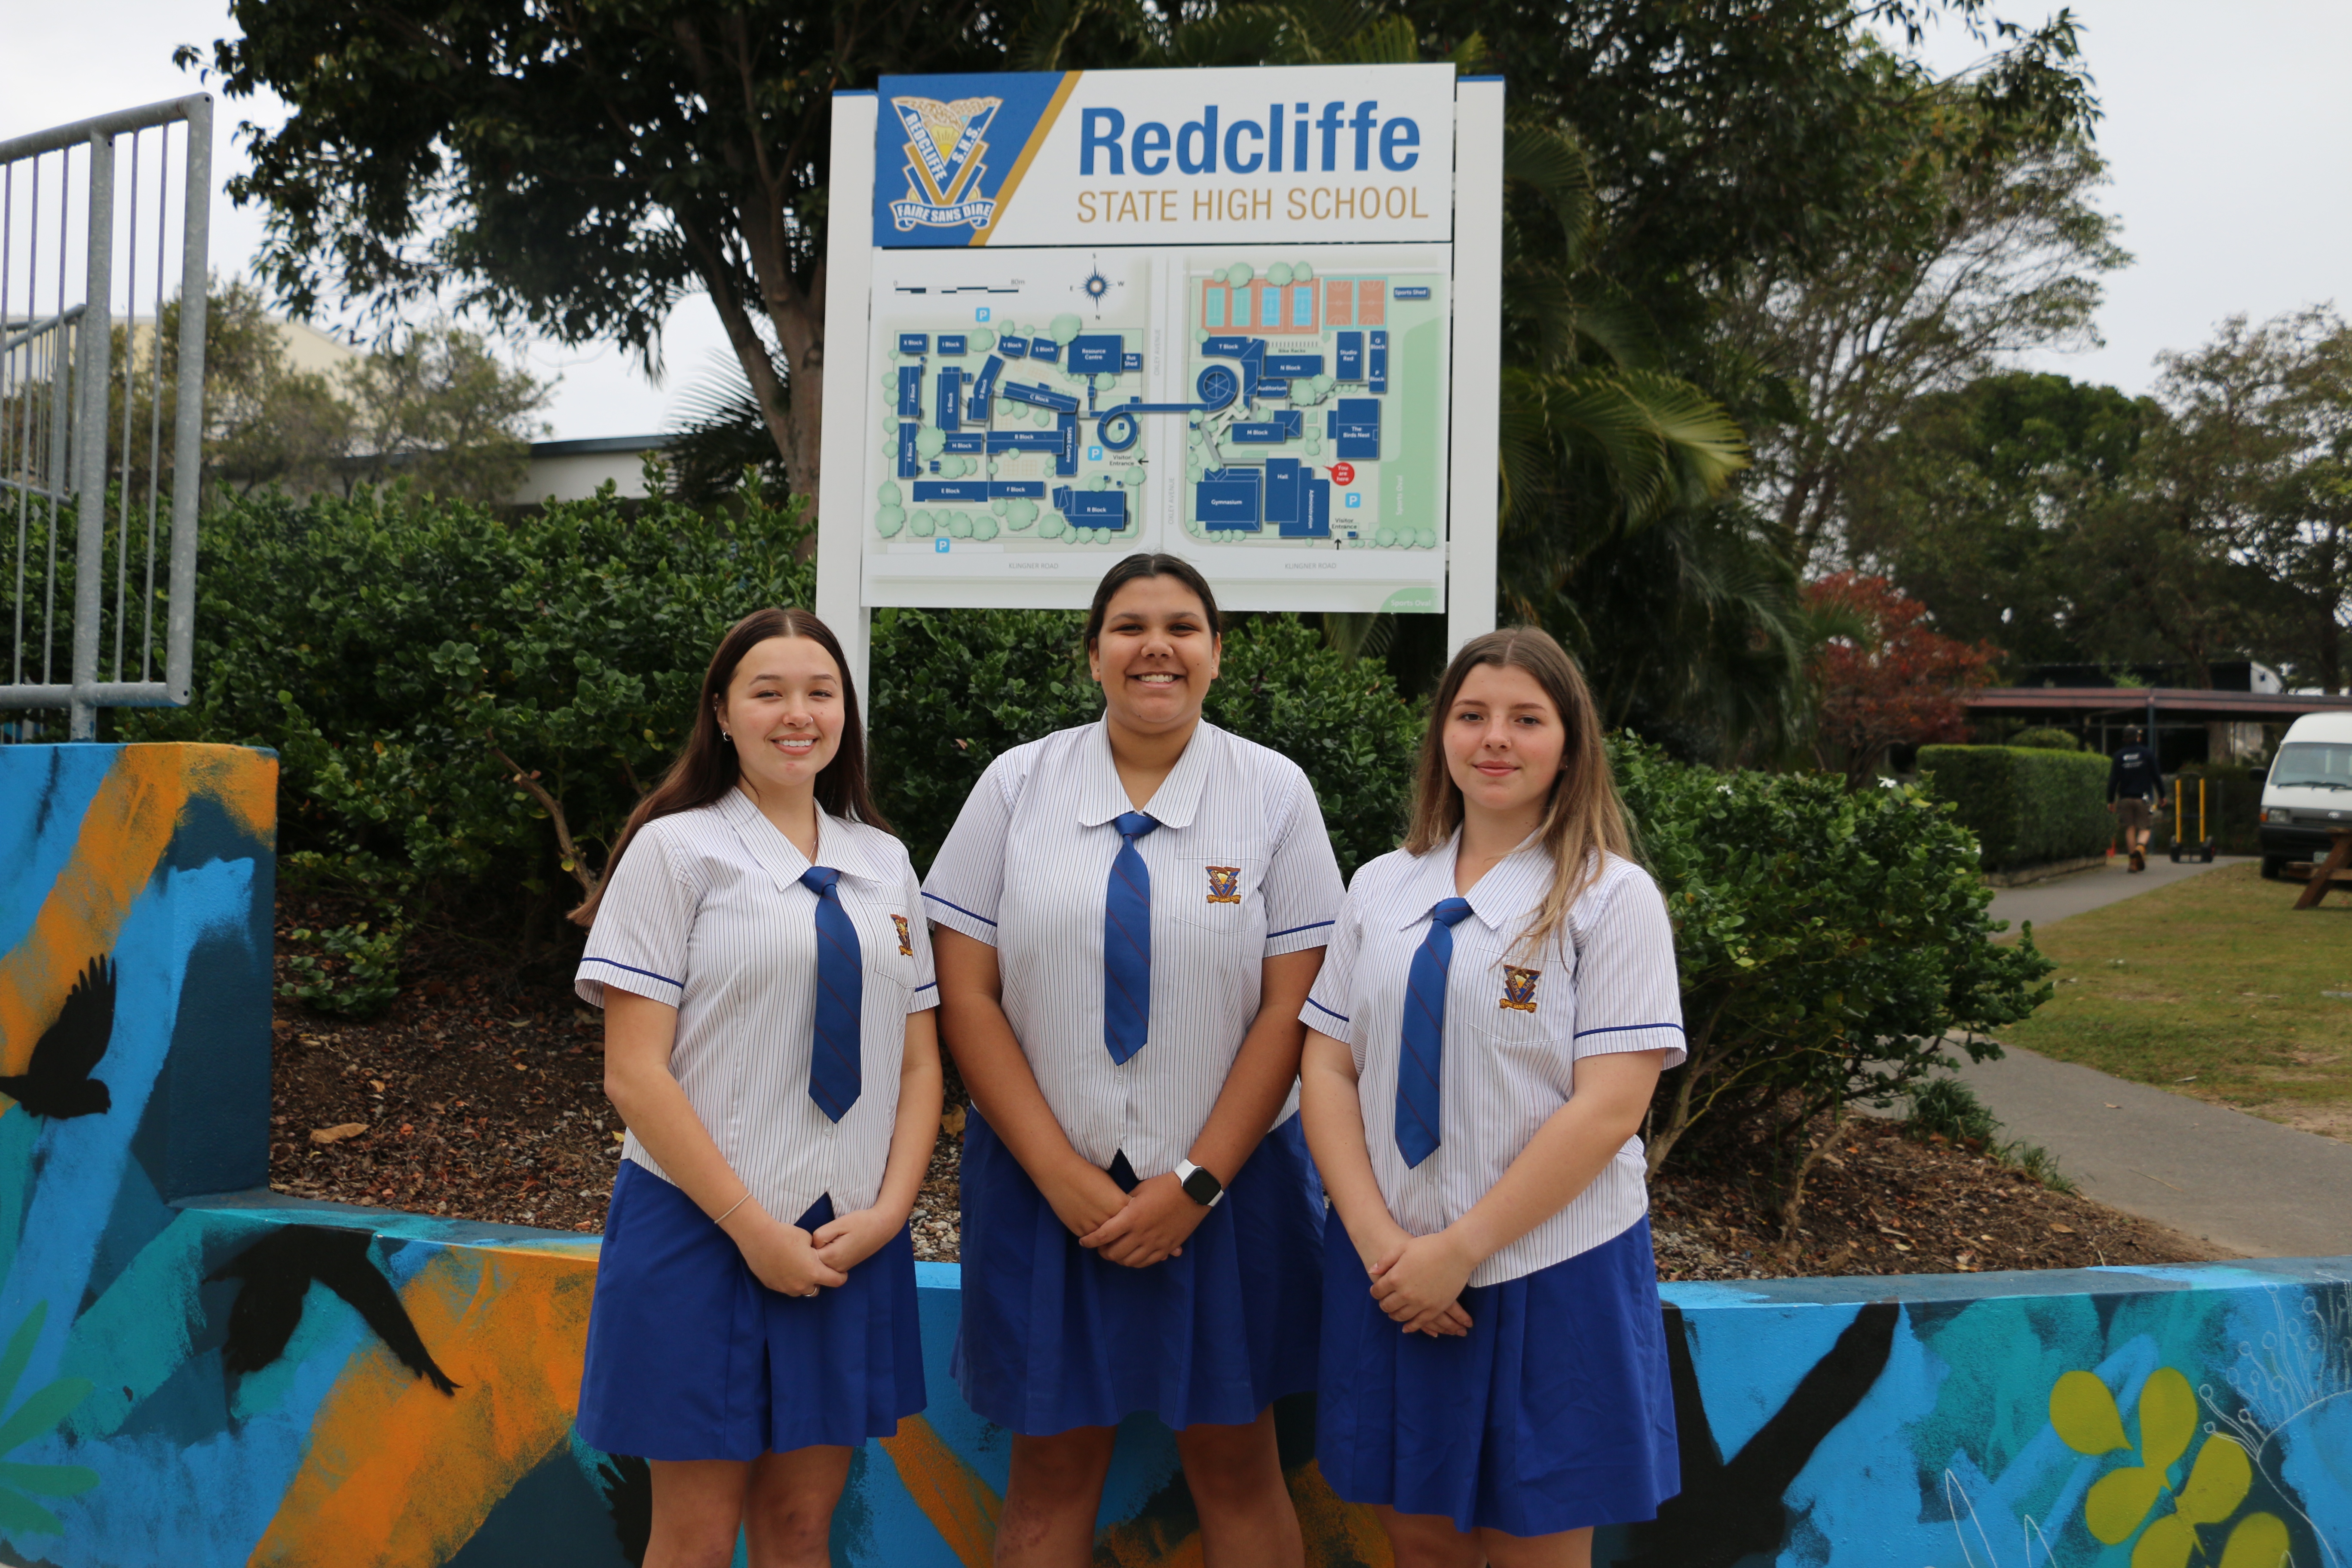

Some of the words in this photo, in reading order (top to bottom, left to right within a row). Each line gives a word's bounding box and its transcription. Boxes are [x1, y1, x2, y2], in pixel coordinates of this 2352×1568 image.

[905, 112, 947, 182] REDCLIFFE
[1079, 100, 1420, 175] Redcliffe
[897, 204, 930, 220] FAIRE
[931, 208, 962, 222] SANS
[962, 203, 992, 217] DIRE
[1077, 189, 1178, 224] STATE
[1193, 188, 1271, 221] HIGH
[1287, 186, 1429, 220] SCHOOL
